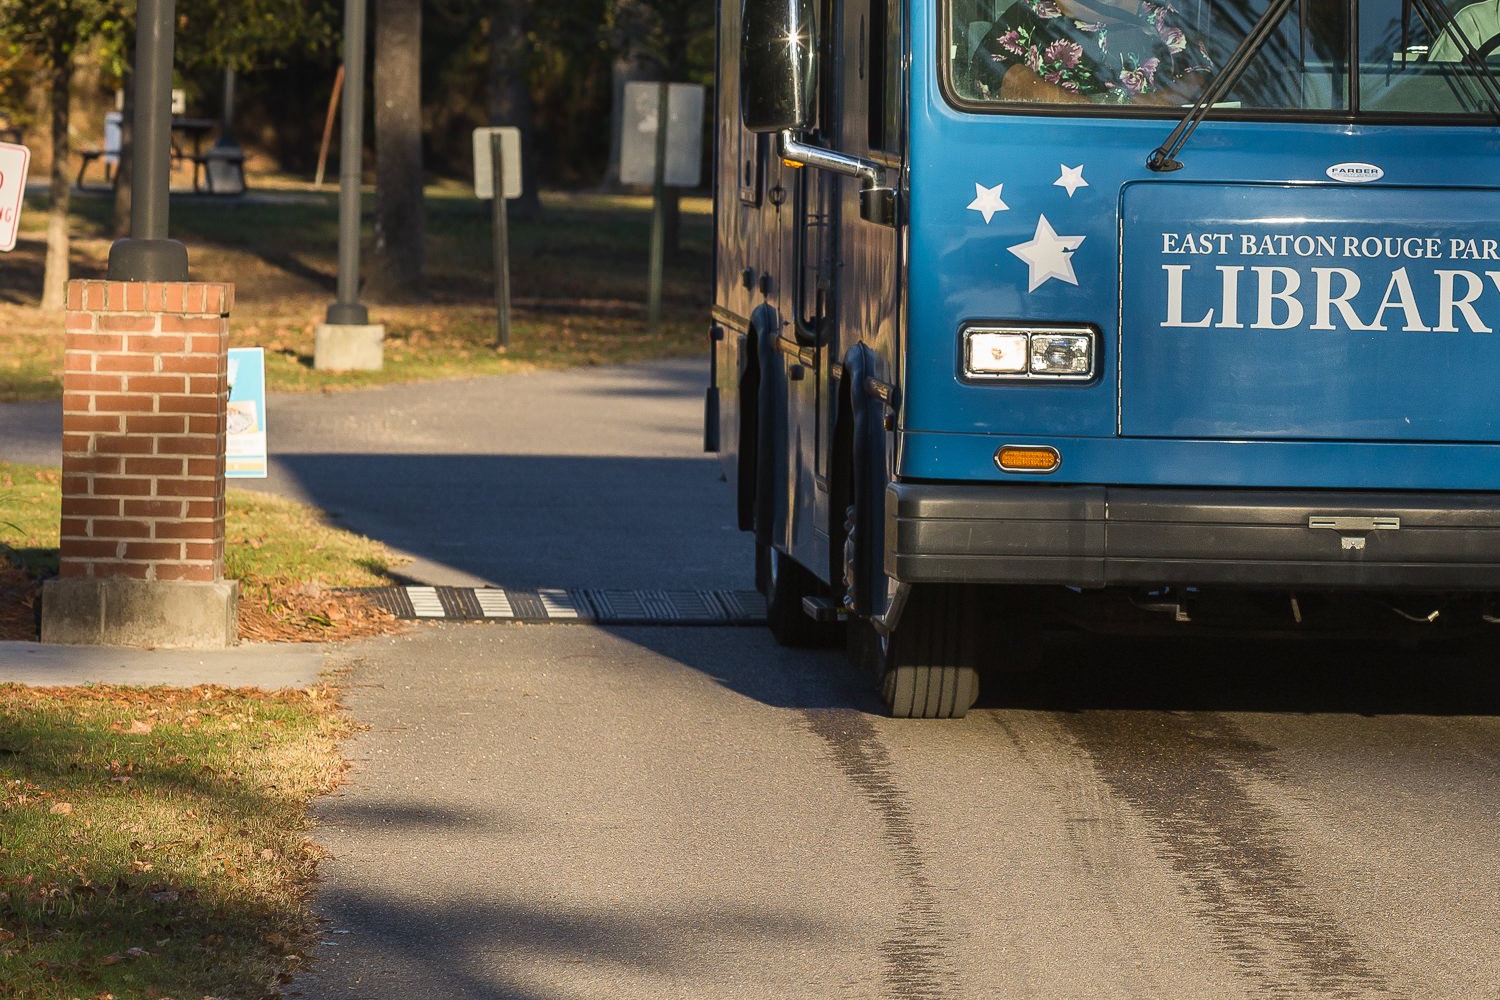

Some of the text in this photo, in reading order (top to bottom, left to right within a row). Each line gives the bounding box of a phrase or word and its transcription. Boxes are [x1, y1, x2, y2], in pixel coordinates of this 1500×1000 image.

[1331, 167, 1379, 175] FARBER
[1161, 233, 1234, 255] EAST
[1239, 234, 1337, 257] BATON
[1343, 236, 1443, 259] ROUGE
